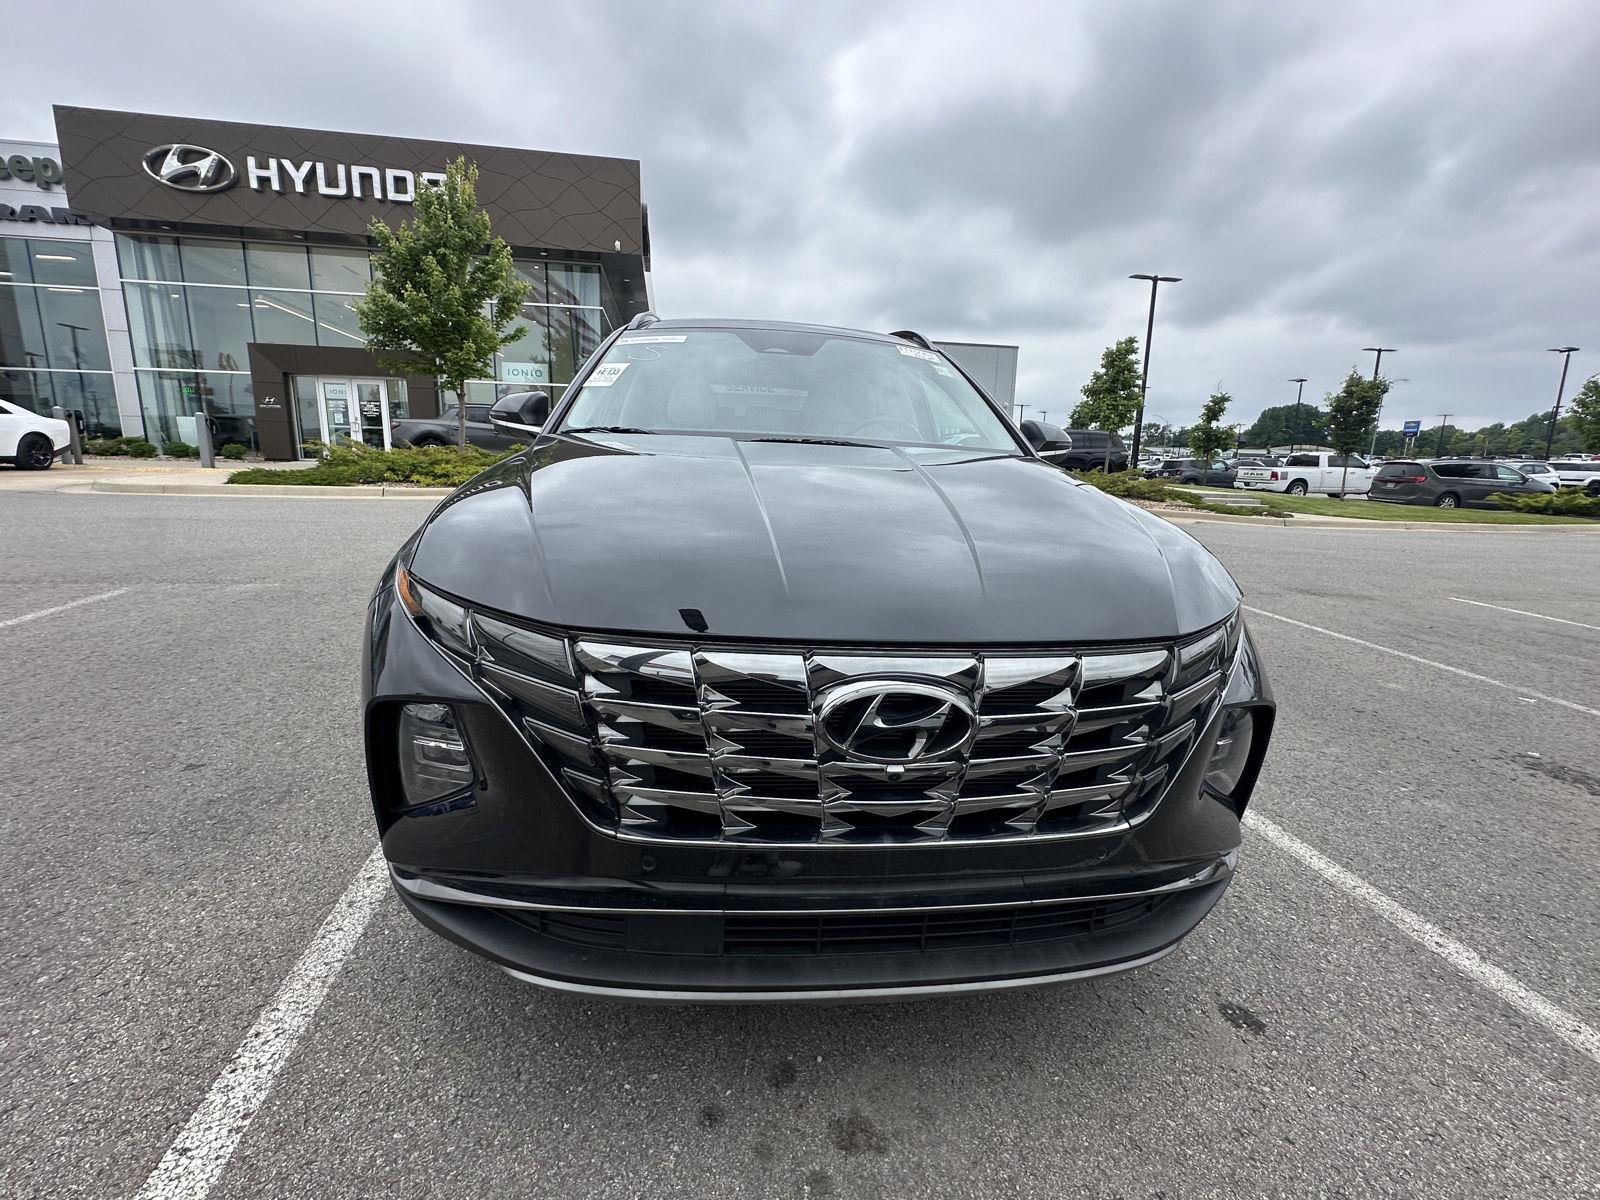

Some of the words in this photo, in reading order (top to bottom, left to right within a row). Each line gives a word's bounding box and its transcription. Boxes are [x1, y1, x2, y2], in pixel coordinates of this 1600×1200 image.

[0, 155, 63, 190] ep
[247, 156, 448, 202] HYUNDA
[507, 368, 543, 378] IONIQ
[329, 388, 347, 396] IONI
[726, 383, 777, 393] SERVICE
